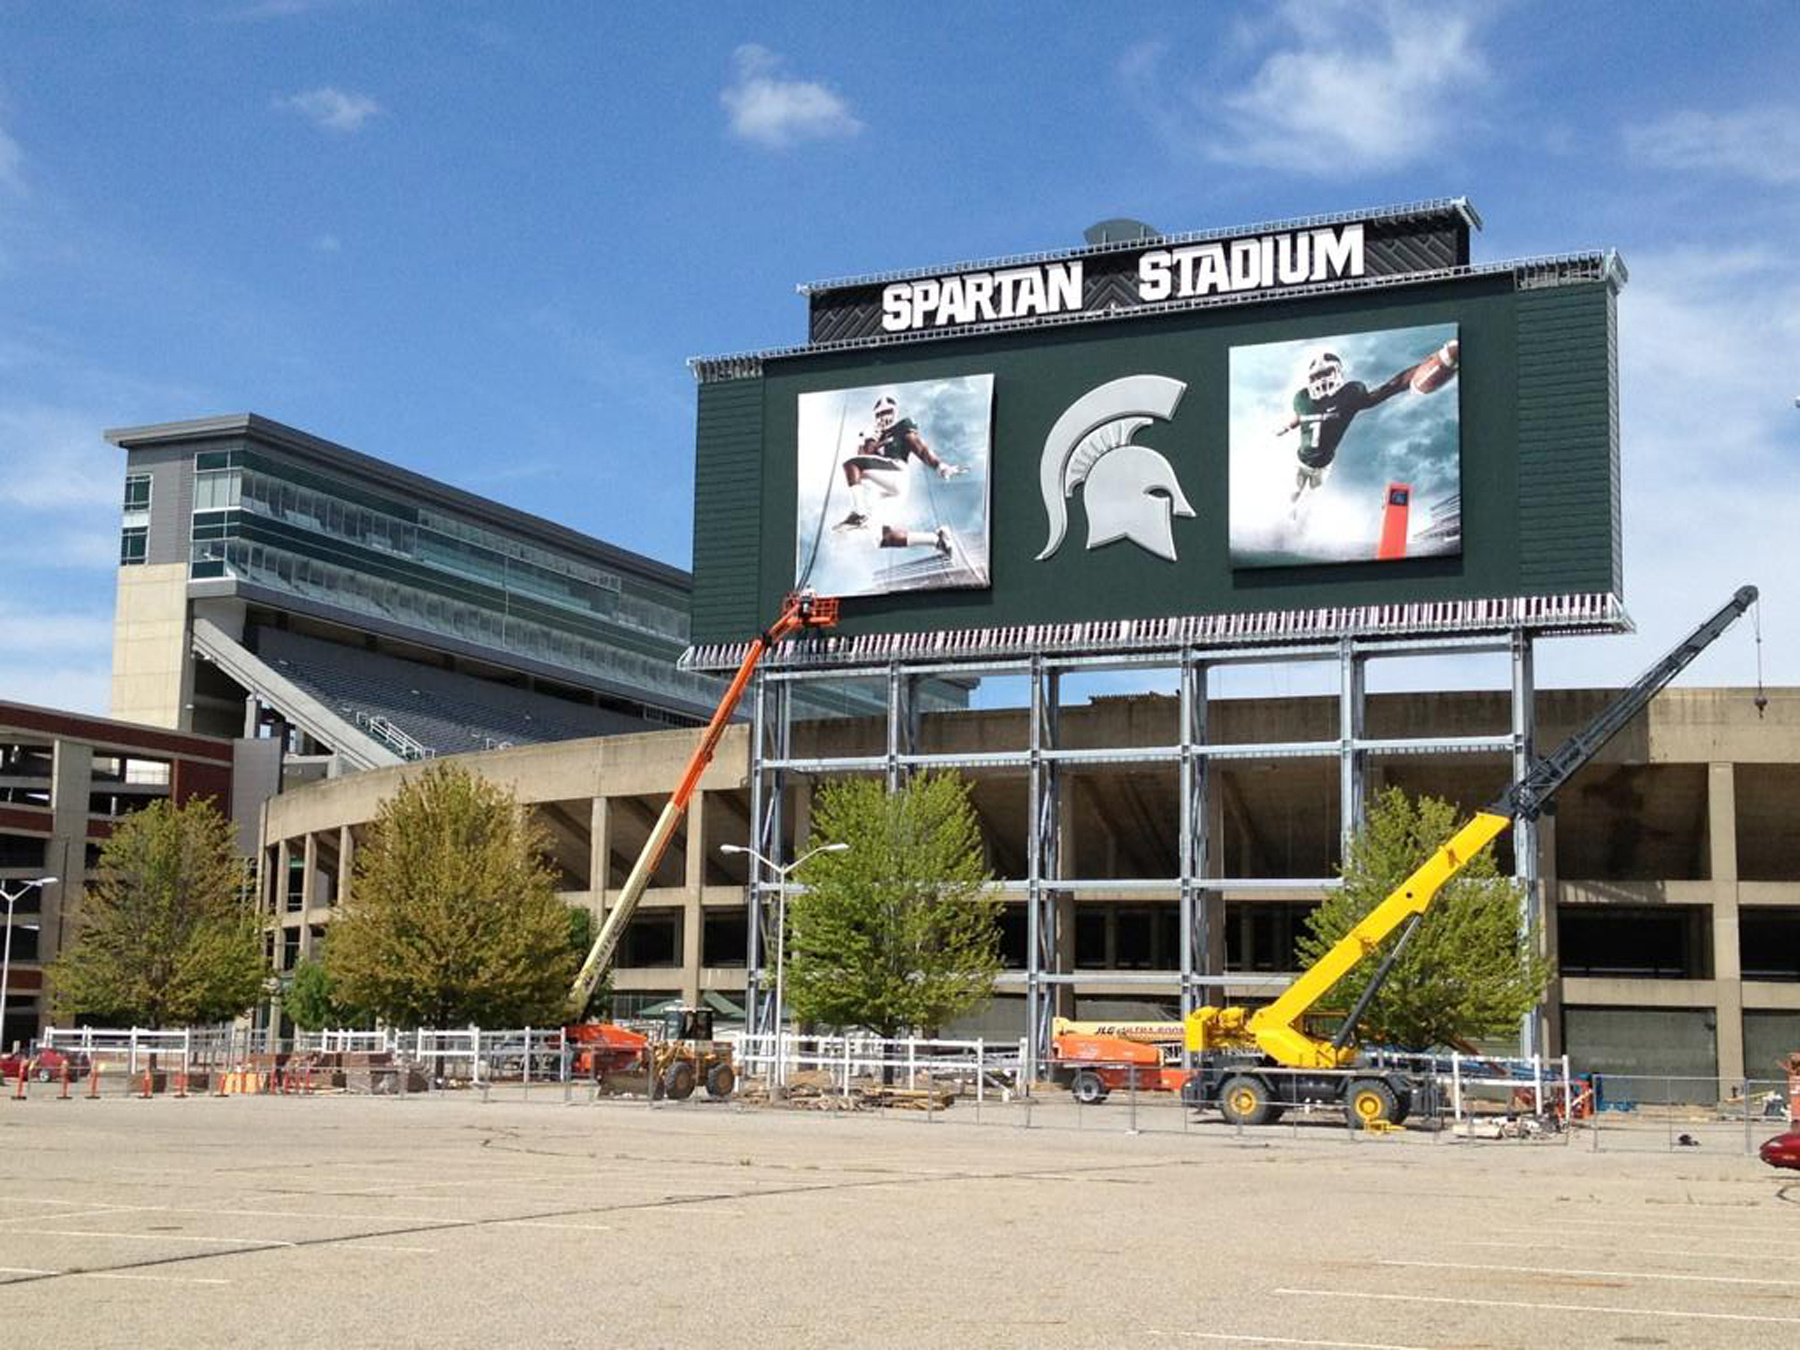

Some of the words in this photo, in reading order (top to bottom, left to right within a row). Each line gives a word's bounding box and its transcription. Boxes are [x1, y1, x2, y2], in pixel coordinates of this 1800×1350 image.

[882, 261, 1083, 332] SPARTAN
[1138, 223, 1365, 302] STADIUM
[1094, 1025, 1116, 1035] JLG
